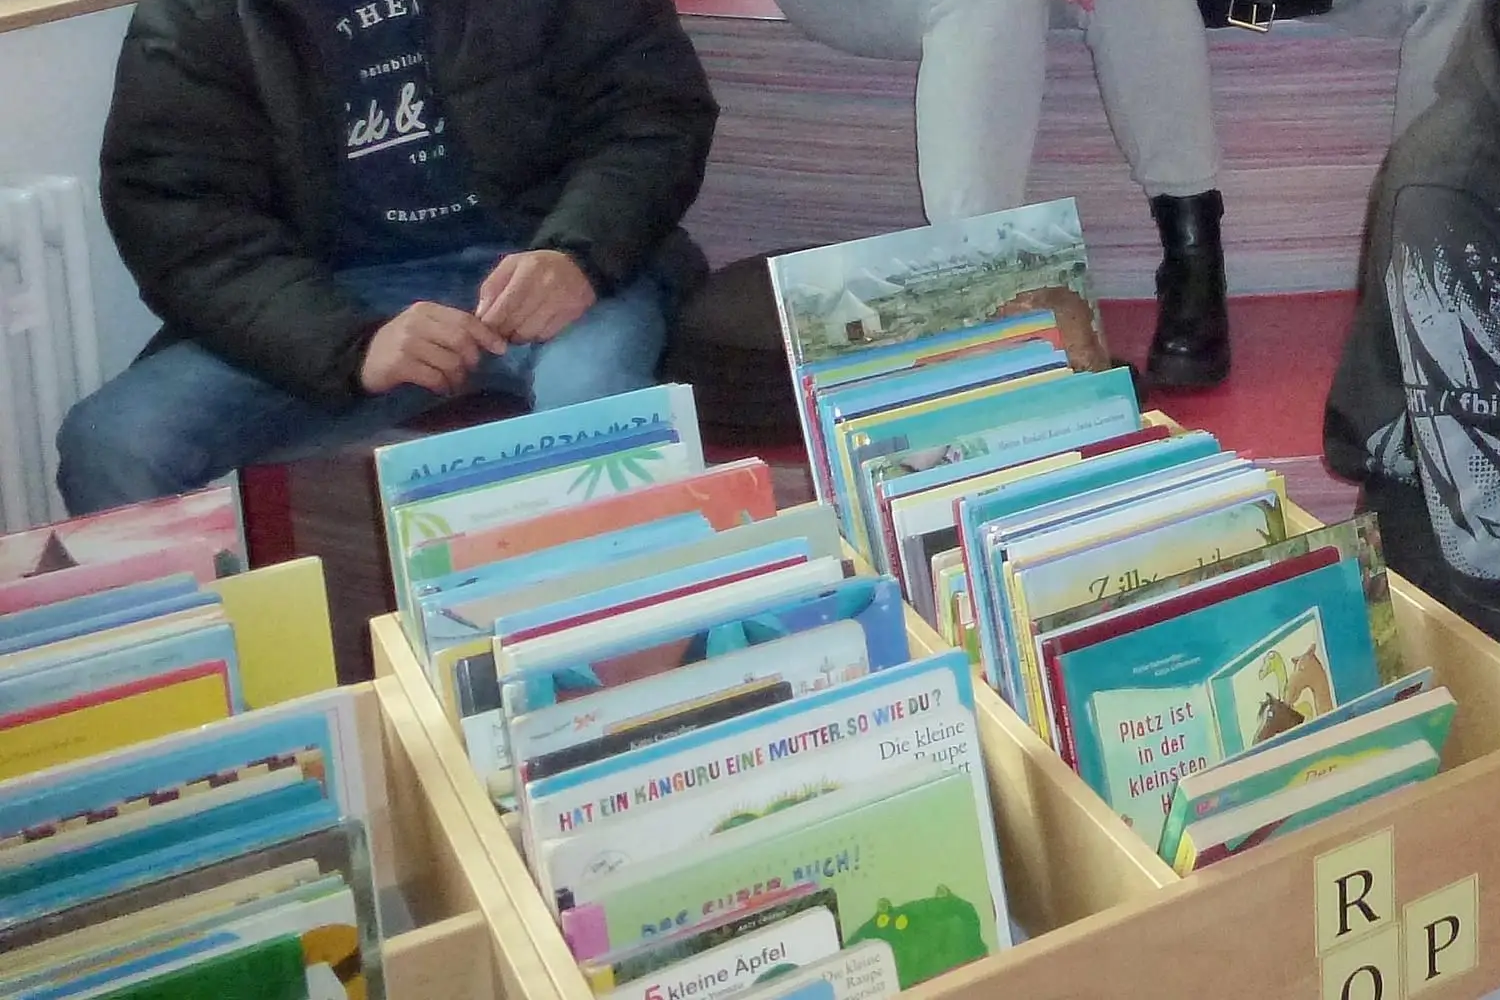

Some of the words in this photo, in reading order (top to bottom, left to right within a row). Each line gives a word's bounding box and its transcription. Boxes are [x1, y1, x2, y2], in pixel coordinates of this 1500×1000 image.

[386, 202, 462, 223] CRAFTED
[880, 739, 911, 761] Die
[915, 722, 967, 748] kleine
[1119, 713, 1163, 743] Platz
[1170, 702, 1194, 725] ist
[559, 803, 594, 832] HAT
[600, 791, 629, 817] EIN
[634, 760, 721, 805] KÄNGURU
[726, 747, 765, 776] EINE
[847, 714, 869, 736] SO
[872, 701, 905, 727] WIE
[914, 740, 969, 765] upe
[1138, 746, 1154, 765] in
[1161, 734, 1186, 756] der
[1129, 756, 1207, 798] kleinsten
[1334, 869, 1381, 937] R
[1424, 915, 1460, 981] P
[667, 964, 730, 1000] kleine
[734, 941, 788, 980] Äpfel
